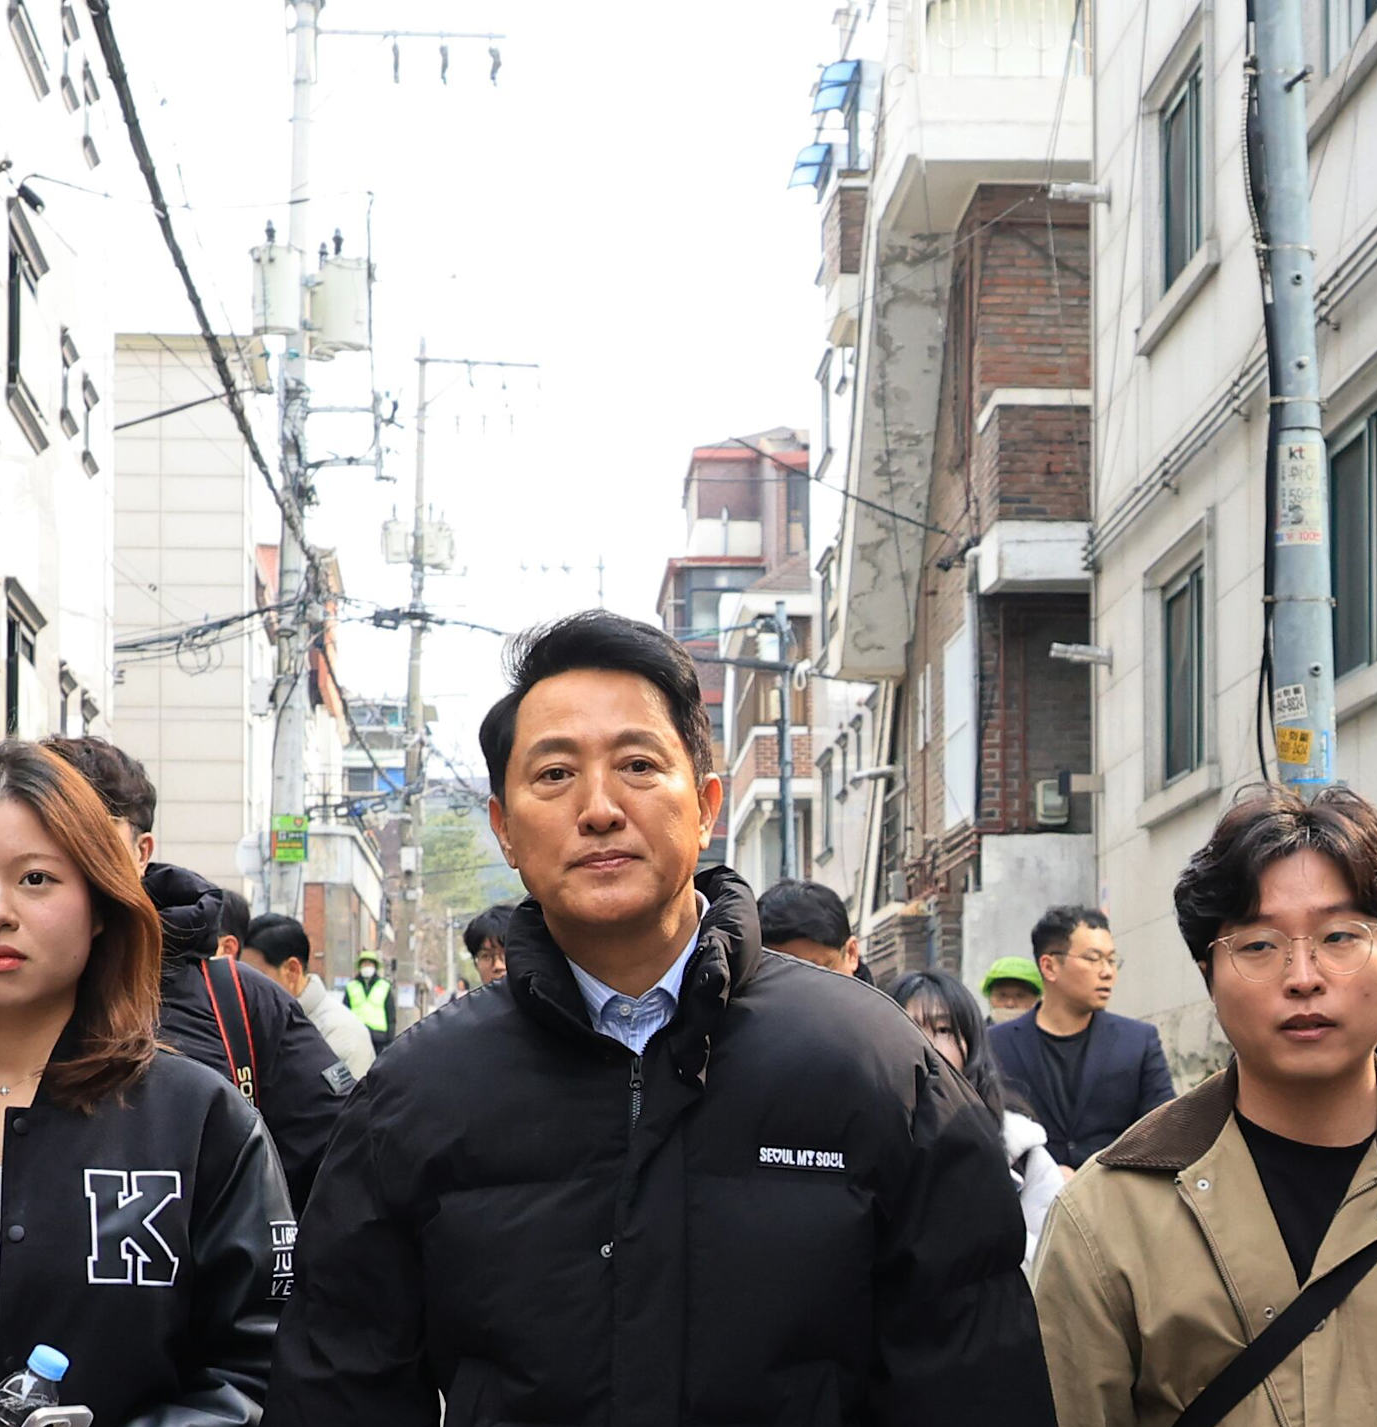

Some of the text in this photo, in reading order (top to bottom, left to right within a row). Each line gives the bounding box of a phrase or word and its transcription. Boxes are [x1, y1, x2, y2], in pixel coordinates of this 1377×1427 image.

[1288, 446, 1306, 459] kt
[759, 1147, 796, 1165] SEOUL
[815, 1151, 845, 1169] SOUL
[84, 1169, 181, 1286] K
